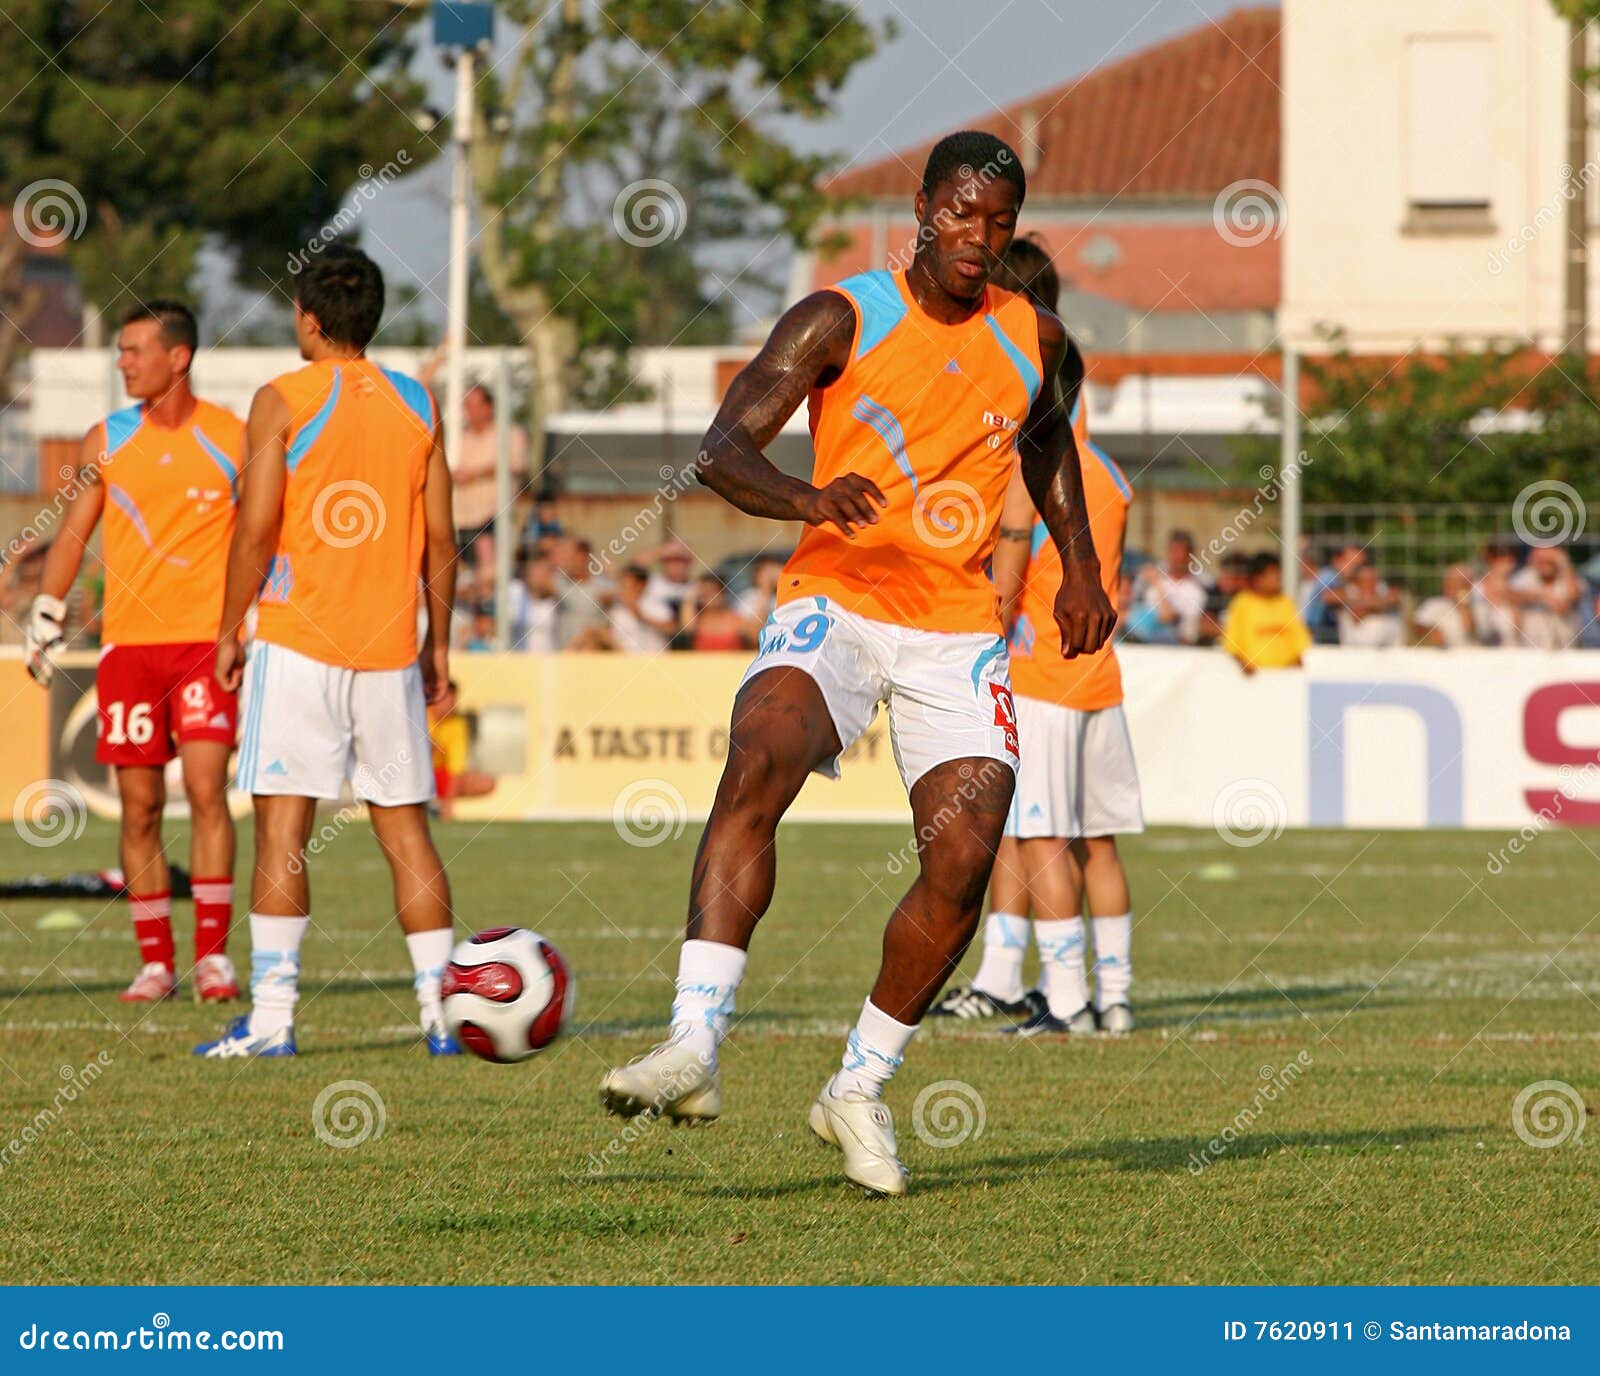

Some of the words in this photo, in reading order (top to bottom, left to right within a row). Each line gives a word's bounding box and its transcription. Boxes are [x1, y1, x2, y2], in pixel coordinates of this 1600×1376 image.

[787, 613, 830, 653] 9
[106, 701, 154, 745] 16
[554, 728, 577, 761] A
[589, 728, 695, 761] TASTE
